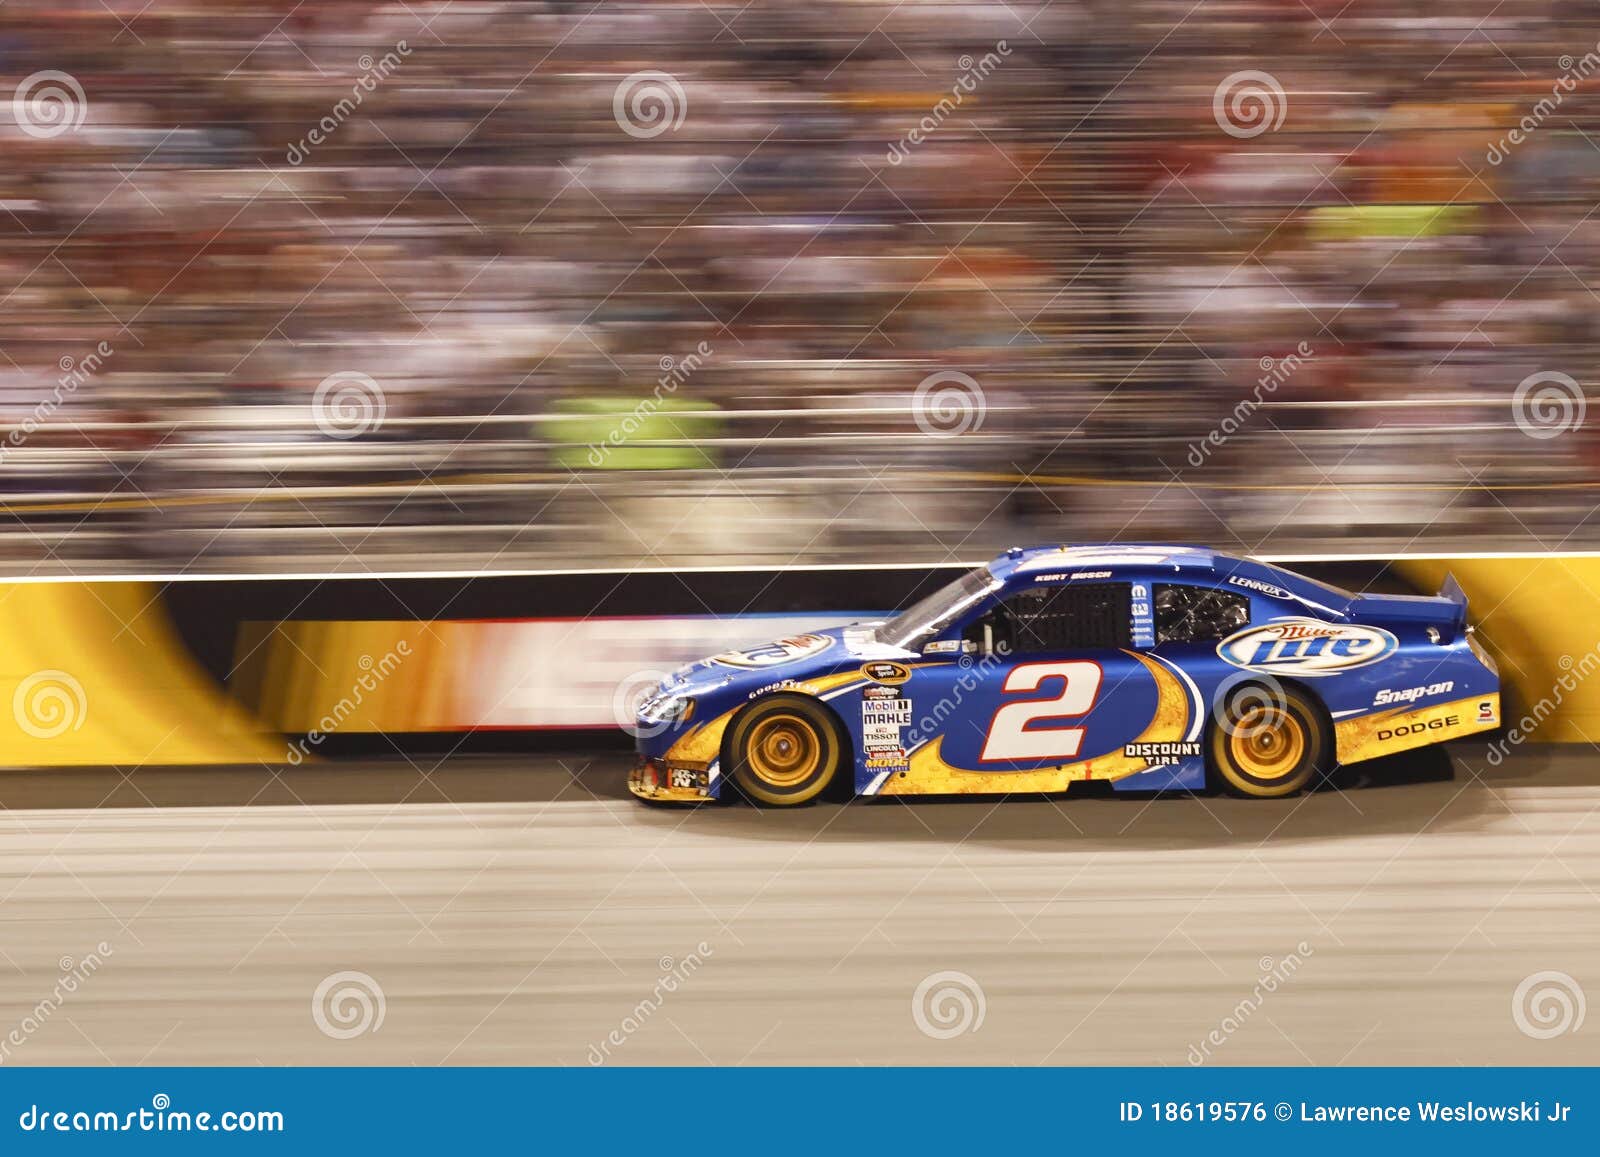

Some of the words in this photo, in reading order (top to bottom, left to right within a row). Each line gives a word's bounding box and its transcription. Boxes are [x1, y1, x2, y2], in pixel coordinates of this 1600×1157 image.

[1034, 573, 1068, 582] KURT
[1070, 571, 1113, 580] BUSCH
[1229, 576, 1282, 597] LENNOX
[1266, 624, 1346, 641] Miller
[1248, 635, 1371, 666] Lite
[1372, 681, 1454, 706] Snap-on
[865, 701, 896, 711] Mobil
[898, 700, 909, 710] 1
[979, 659, 1103, 763] 2
[863, 712, 911, 725] MAHLE
[1377, 715, 1460, 741] DODGE
[864, 733, 899, 741] TISSOT
[1125, 743, 1201, 757] DISCOUNT
[1145, 756, 1180, 766] TIRE
